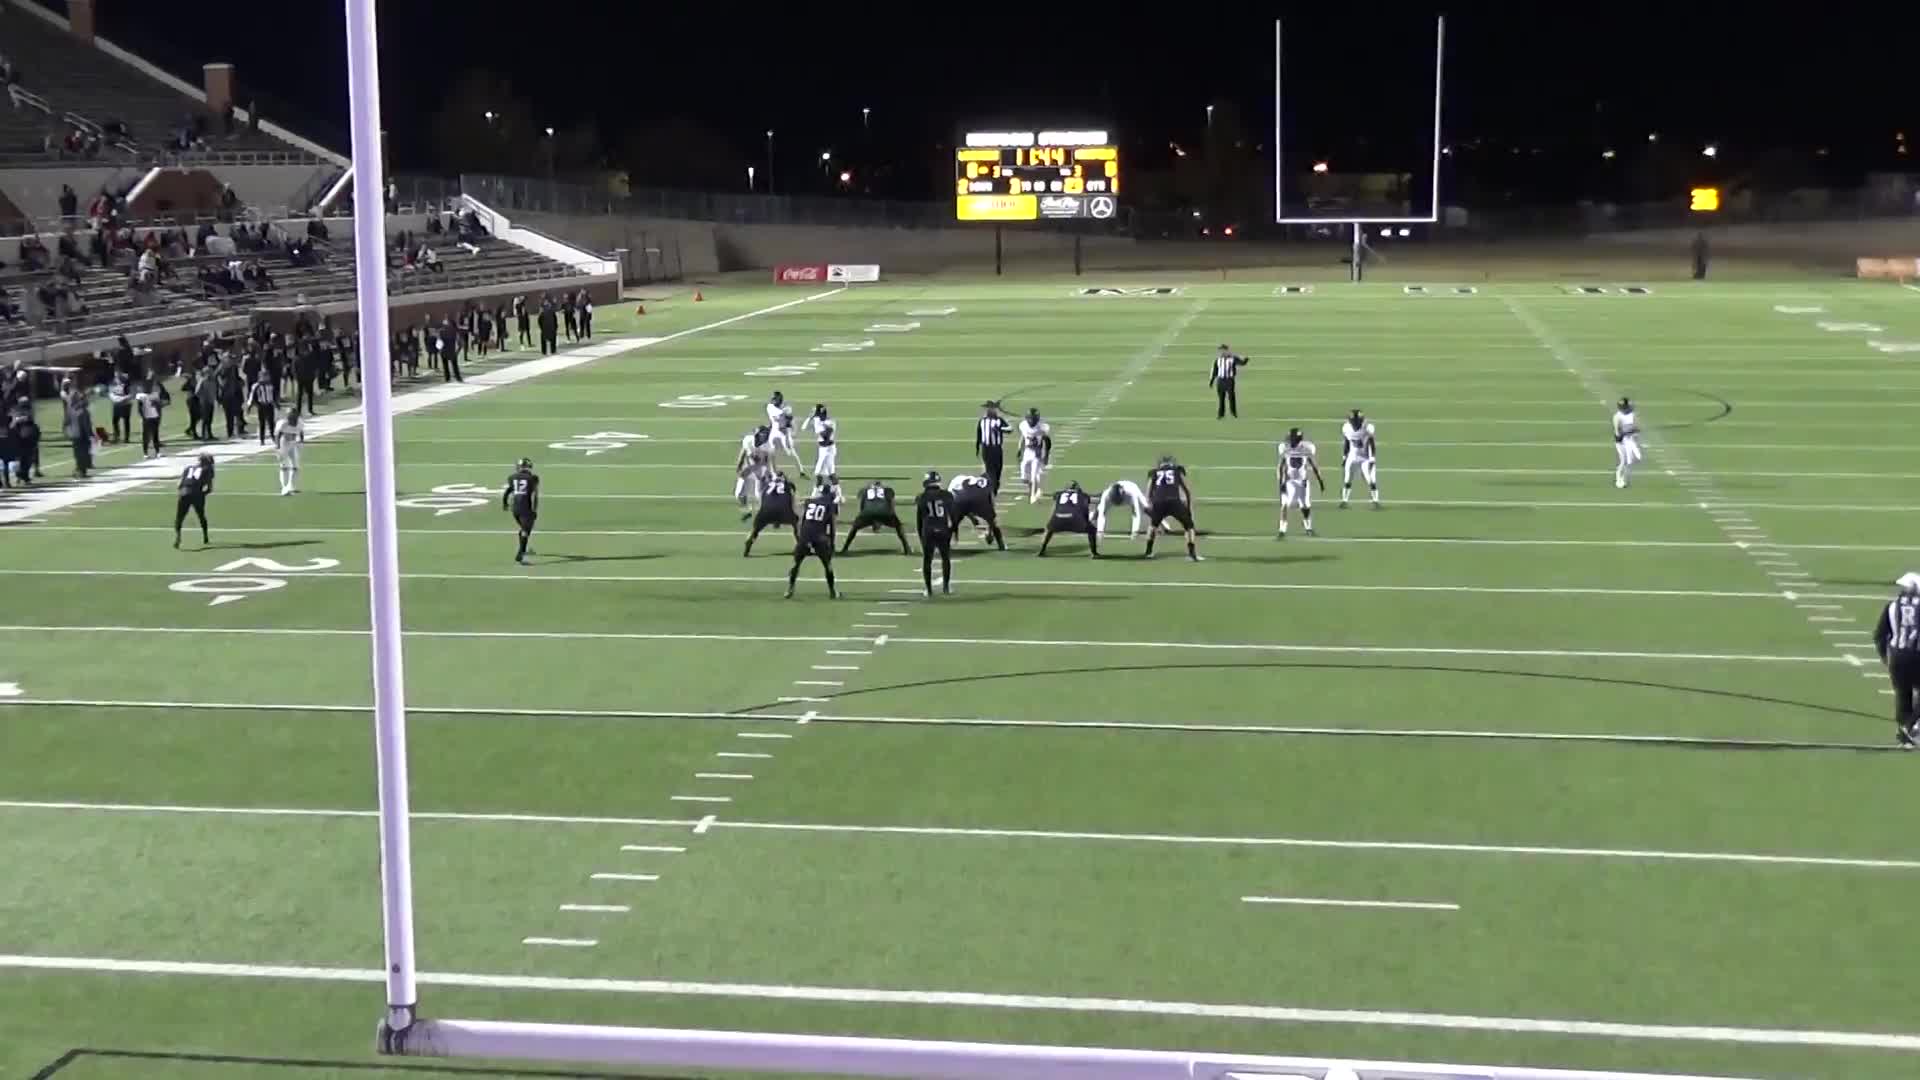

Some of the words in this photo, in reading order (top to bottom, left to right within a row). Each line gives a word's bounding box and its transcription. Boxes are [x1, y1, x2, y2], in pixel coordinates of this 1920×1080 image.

[1156, 469, 1175, 486] 75
[513, 479, 528, 494] 12
[805, 503, 826, 521] 20
[927, 500, 945, 518] 16
